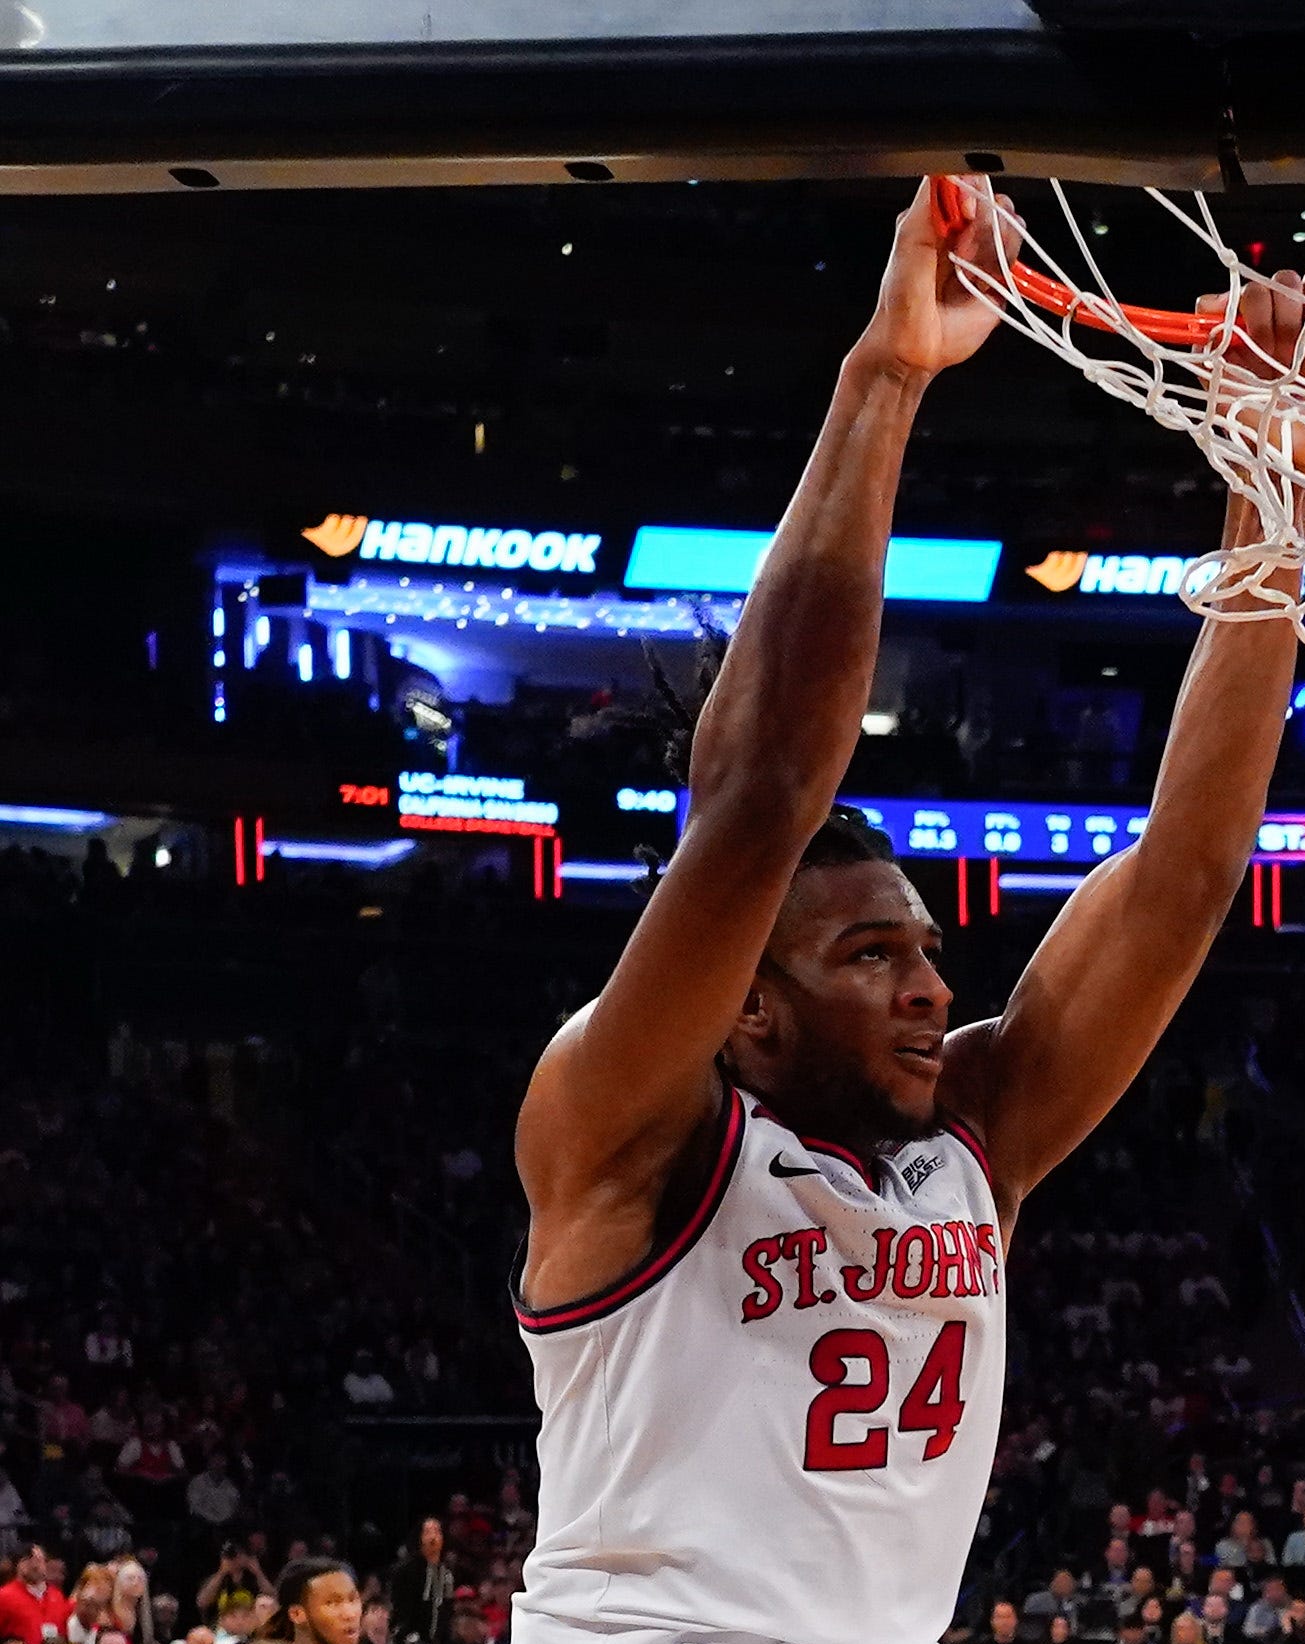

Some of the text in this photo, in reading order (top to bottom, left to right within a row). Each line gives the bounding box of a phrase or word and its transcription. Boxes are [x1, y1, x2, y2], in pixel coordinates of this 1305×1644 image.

[901, 1155, 925, 1181] BIG
[741, 1226, 837, 1324] ST.
[803, 1321, 966, 1471] 24
